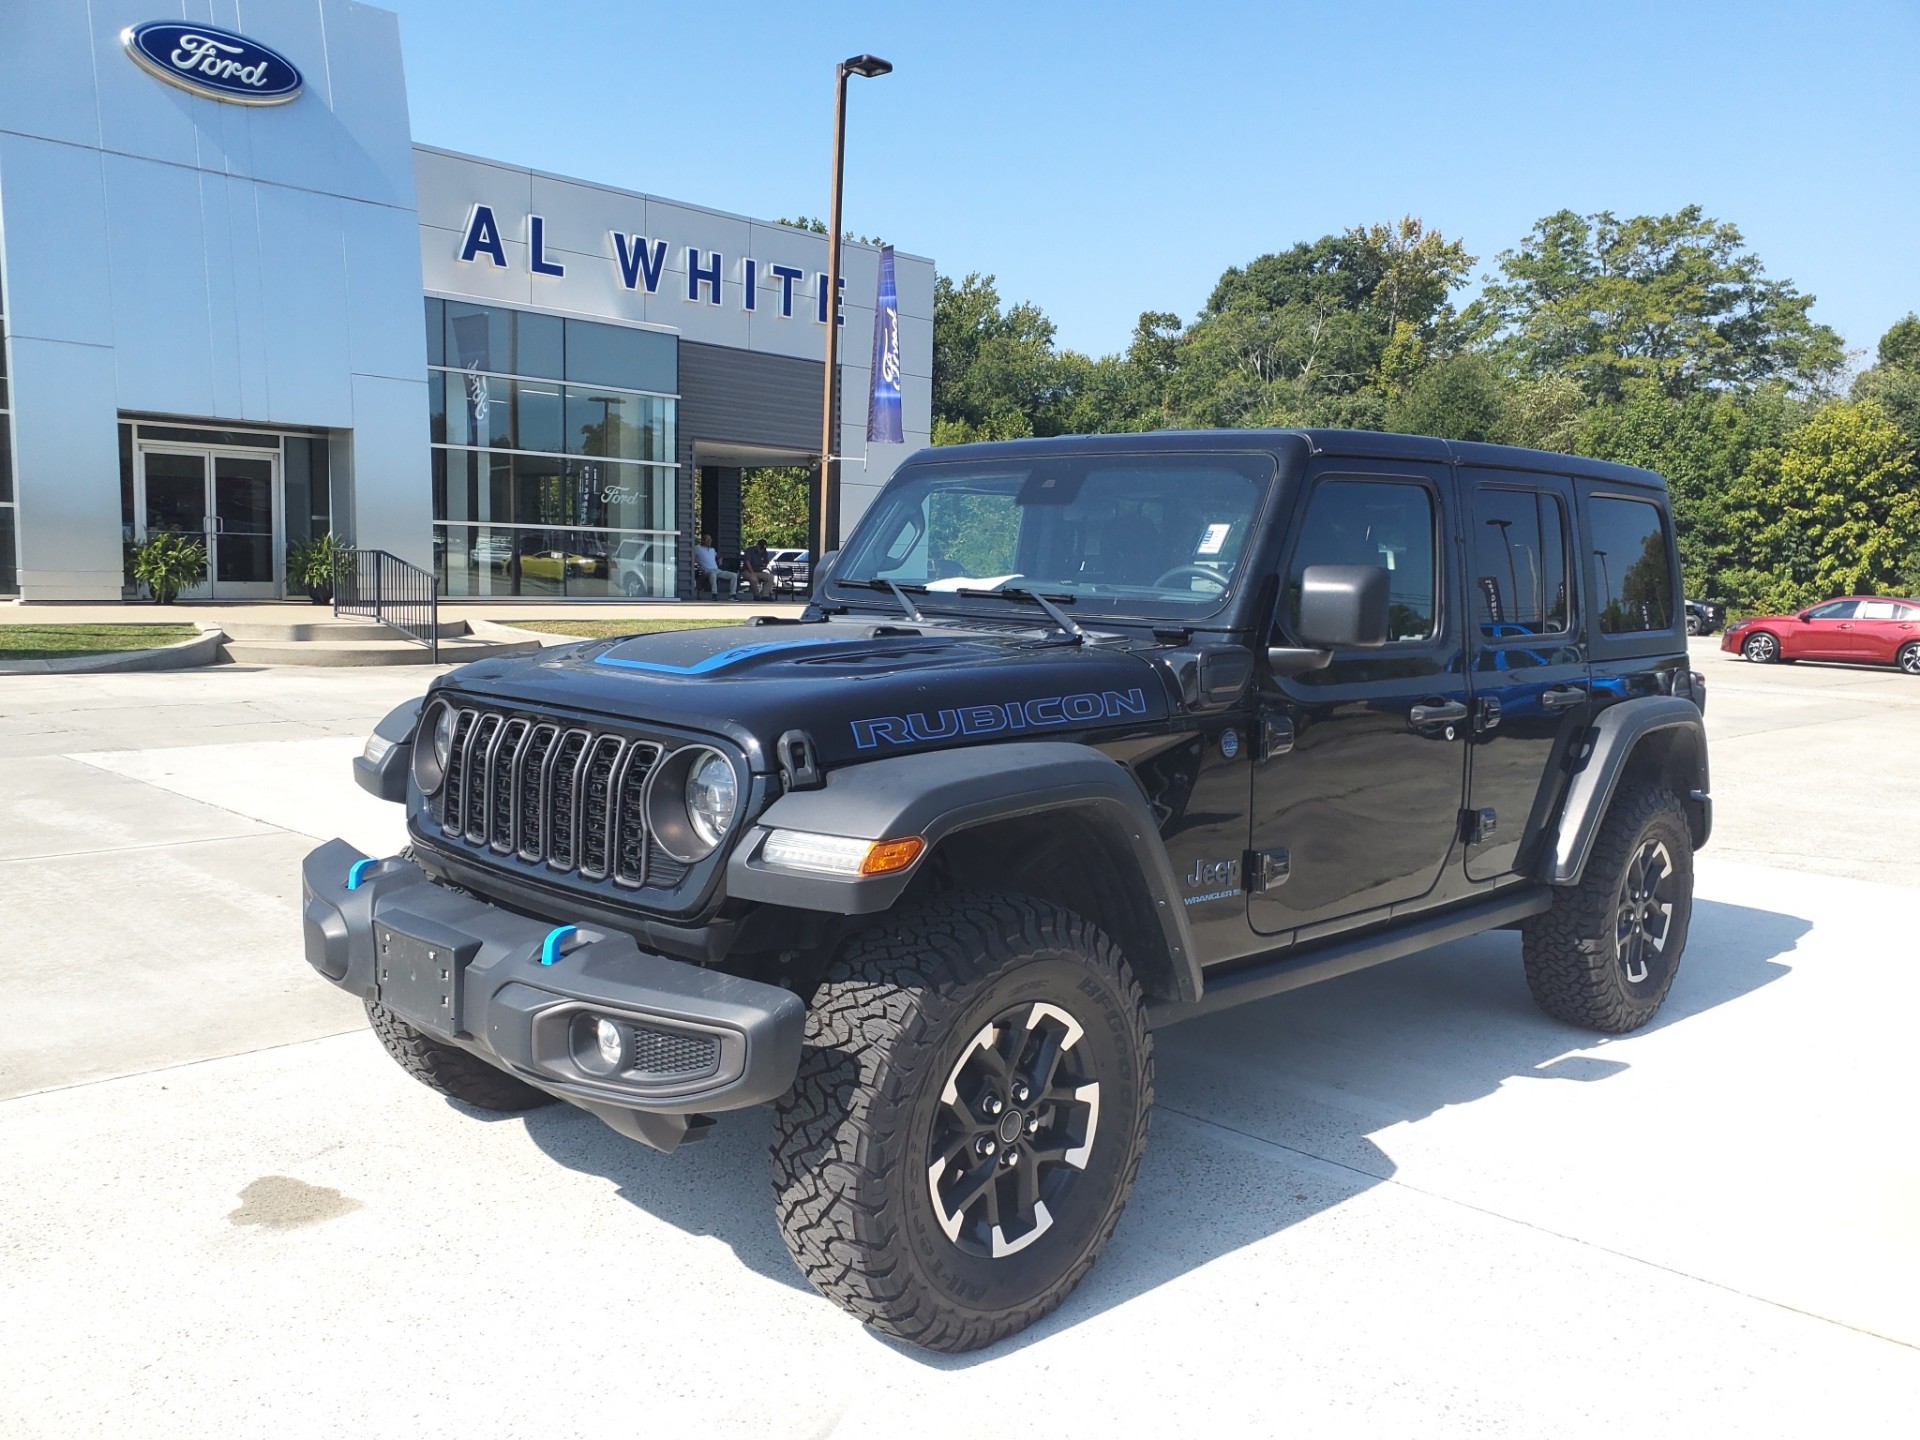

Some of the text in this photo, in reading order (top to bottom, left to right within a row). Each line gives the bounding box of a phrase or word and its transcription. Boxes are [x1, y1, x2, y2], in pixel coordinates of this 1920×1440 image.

[171, 34, 268, 87] Ford
[458, 203, 847, 328] AL WHITE
[600, 485, 639, 505] Ford
[850, 688, 1146, 749] RUBICON
[1187, 859, 1241, 888] Jeep
[1184, 890, 1233, 905] WRANGLER
